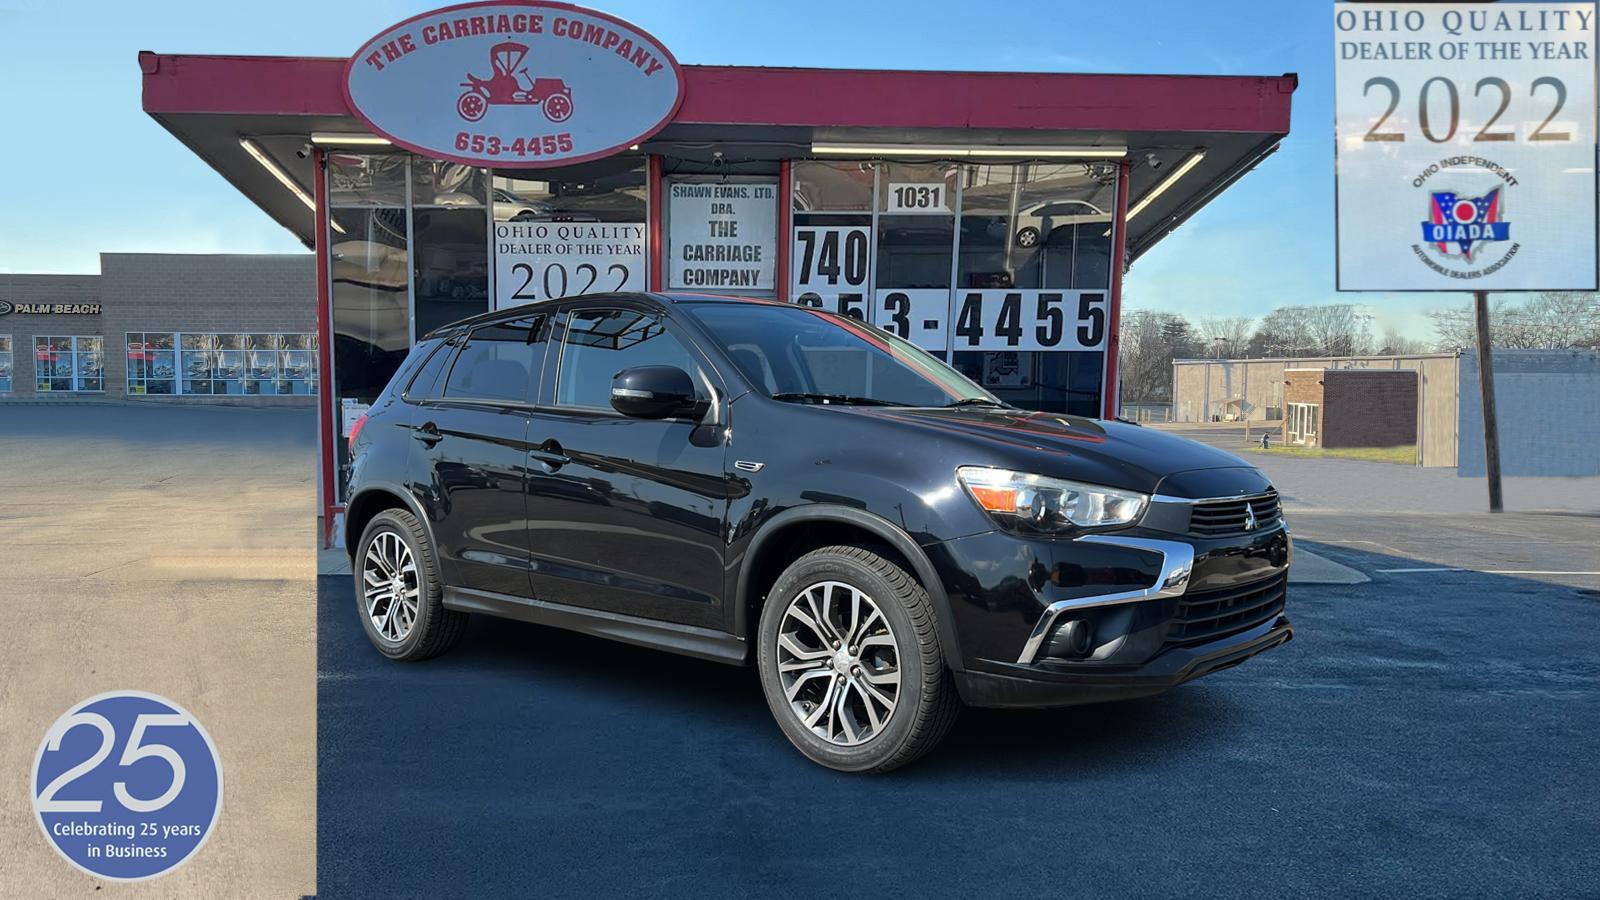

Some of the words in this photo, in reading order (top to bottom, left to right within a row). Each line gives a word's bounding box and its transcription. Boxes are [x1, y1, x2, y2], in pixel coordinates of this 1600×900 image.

[1336, 10, 1425, 31] OHIO
[1442, 10, 1593, 35] QUALITY
[366, 33, 416, 72] THE
[422, 14, 545, 46] CARRIAGE
[552, 17, 664, 77] COMPANY
[1340, 41, 1433, 60] DEALER
[1439, 41, 1469, 60] OF
[1474, 41, 1522, 60] THE
[1527, 41, 1589, 60] YEAR
[1363, 76, 1571, 143] 2022
[454, 132, 573, 157] 653-4455
[1412, 164, 1439, 188] OHIO
[1440, 156, 1519, 187] INDEPENDENT
[672, 186, 712, 199] SHAWN
[714, 186, 751, 199] EVANS.
[754, 187, 775, 199] LTD.
[894, 186, 940, 208] 1031
[711, 203, 736, 215] DBA.
[496, 225, 548, 239] OHIO
[557, 225, 645, 241] QUALITY
[708, 220, 738, 238] THE
[1432, 224, 1495, 240] OIADA
[499, 243, 552, 255] DEALER
[555, 243, 573, 255] OF
[576, 243, 603, 255] THE
[606, 244, 642, 255] YEAR
[683, 244, 762, 262] CARRIAGE
[797, 230, 868, 286] 740
[1411, 244, 1449, 277] AUTOMOBILE
[1449, 268, 1482, 280] DEALERS
[1482, 242, 1521, 277] ASSOCIATION
[511, 262, 630, 300] 2022
[683, 268, 760, 287] COMPANY
[15, 304, 51, 314] PALM
[54, 304, 100, 314] BEACH
[797, 292, 1105, 348] 53-4455
